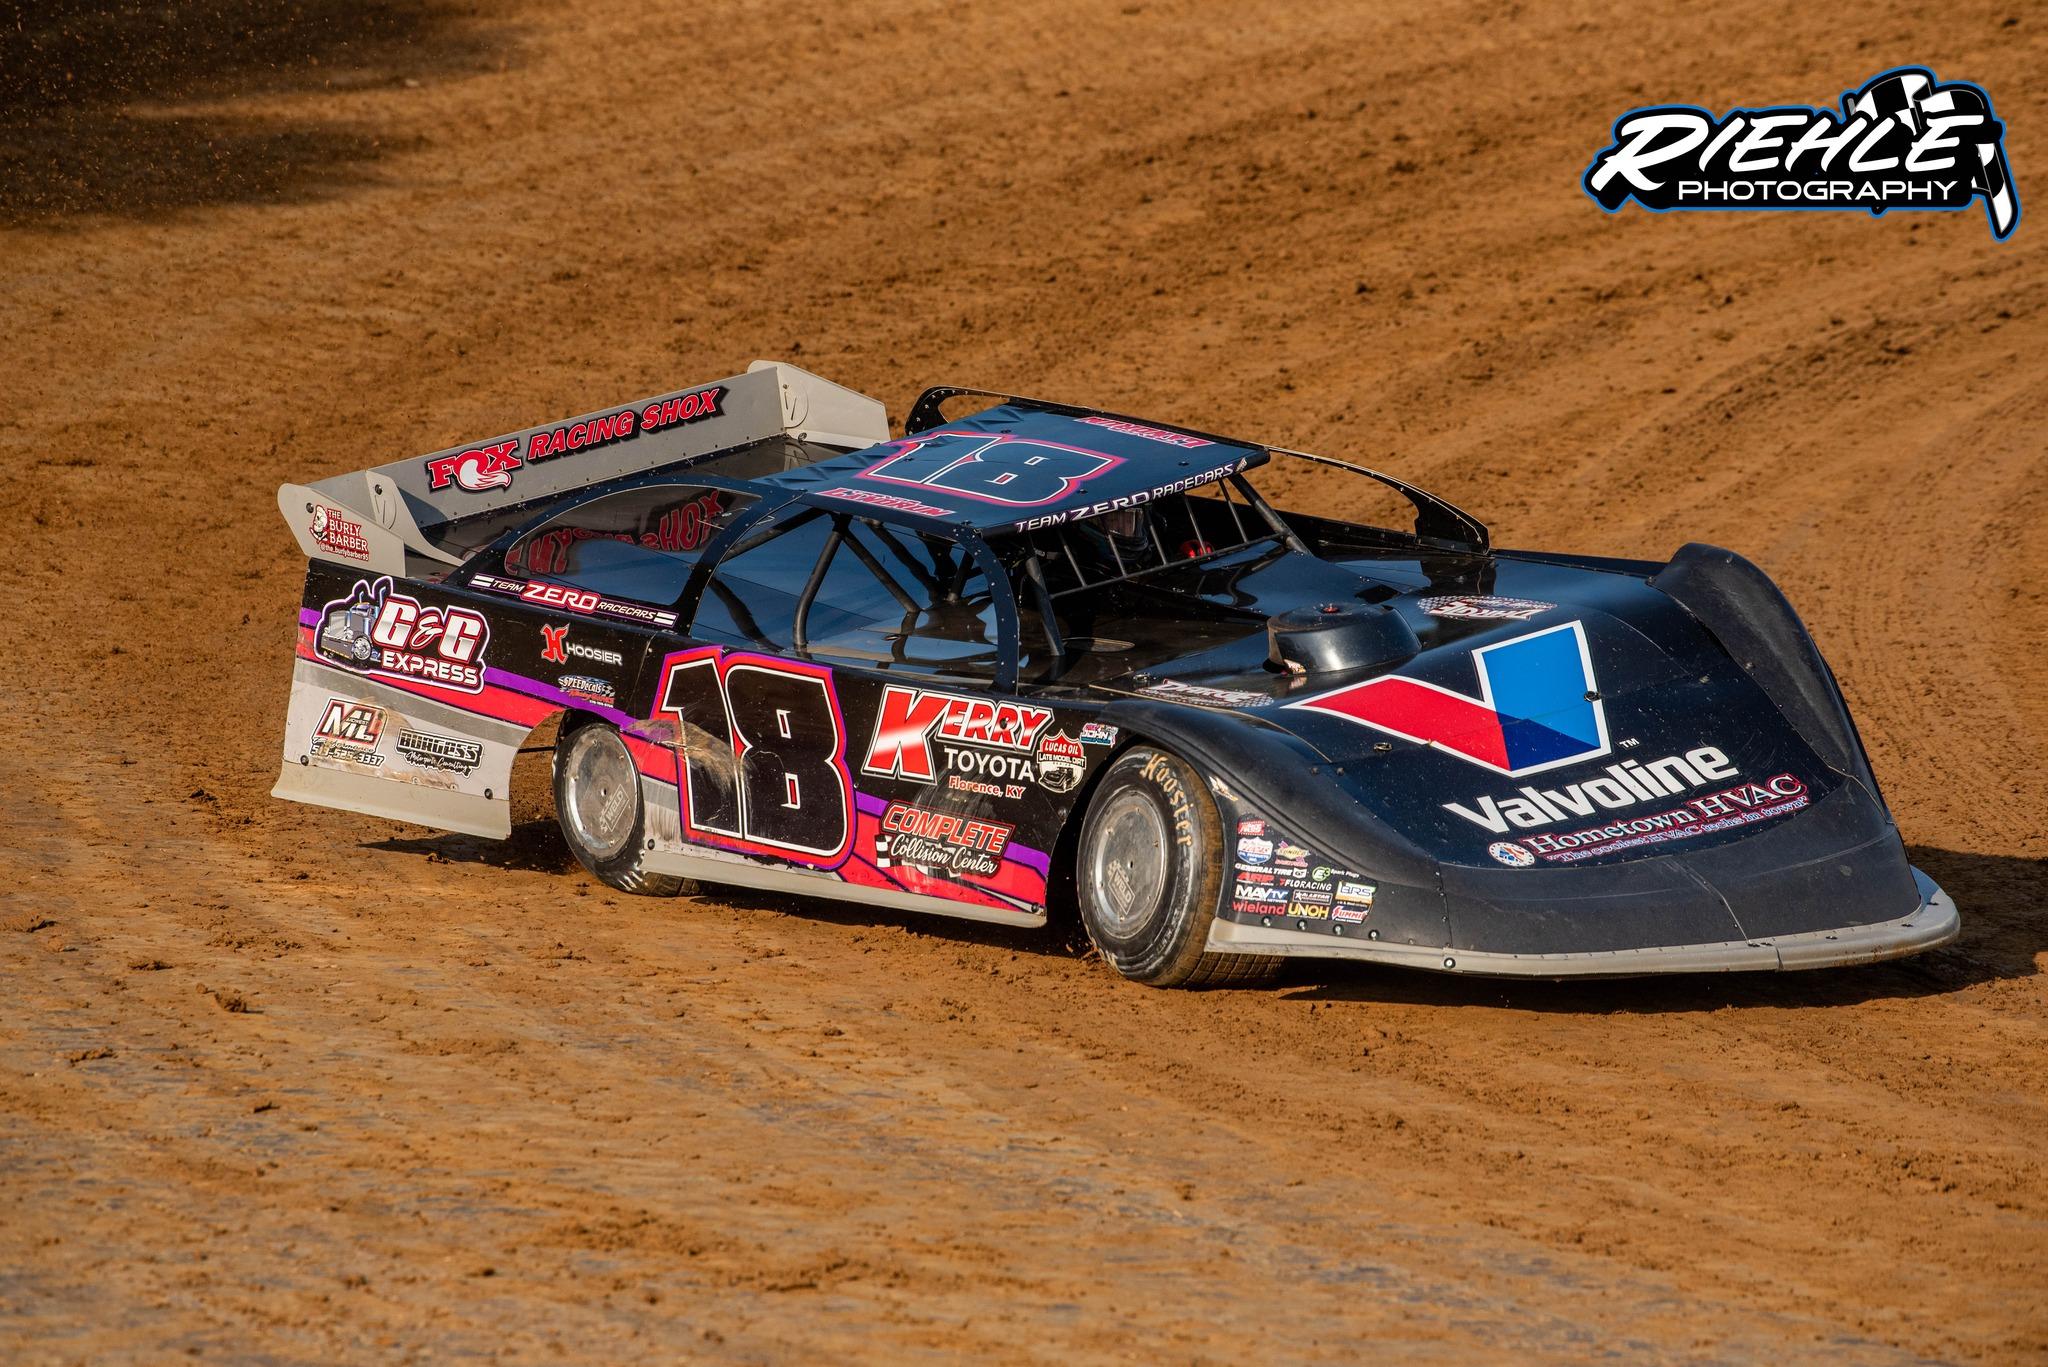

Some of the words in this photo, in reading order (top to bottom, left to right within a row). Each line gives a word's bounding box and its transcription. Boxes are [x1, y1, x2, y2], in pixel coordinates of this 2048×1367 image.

[429, 440, 522, 490] FOX
[528, 410, 634, 460] RACING
[640, 387, 720, 430] SHOX
[857, 431, 1124, 506] 18
[327, 508, 342, 520] THE
[1015, 511, 1067, 534] TEAM
[1070, 490, 1150, 522] ZERO
[1152, 463, 1235, 501] RACECARS
[329, 519, 361, 537] BURLY
[329, 531, 368, 552] BARBER
[491, 579, 525, 593] TEAM
[523, 582, 599, 611] ZERO
[597, 601, 656, 621] RACECARS
[373, 600, 482, 662] G&G
[381, 649, 479, 686] EXPRESS
[566, 641, 623, 666] HOOSIER
[863, 686, 1053, 781] KERRY
[1044, 741, 1067, 754] LUCAS
[1067, 745, 1079, 755] OIL
[1619, 737, 1640, 749] TM
[655, 650, 854, 864] 18
[944, 747, 1036, 783] TOYOTA
[1039, 752, 1053, 762] LATE
[1053, 755, 1072, 764] MODEL
[1072, 757, 1085, 767] DIRT
[948, 776, 1003, 798] Florence,
[1005, 785, 1027, 799] KY
[1139, 752, 1195, 847] Hoosier
[1442, 746, 1740, 834] Valvoline
[606, 790, 625, 821] WELD
[1522, 807, 1693, 856] Hometown
[1690, 775, 1804, 820] HVAC
[883, 804, 1010, 854] COMPLETE
[1592, 836, 1647, 857] coolest
[1646, 825, 1702, 844] HVAC
[1702, 815, 1745, 833] techs
[1743, 809, 1761, 823] in
[890, 833, 952, 864] Collision
[952, 846, 998, 874] Center
[1234, 862, 1273, 875] GENERAL
[1273, 867, 1294, 877] TIRE
[1112, 871, 1133, 903] WELD
[1234, 884, 1289, 900] MAVTV
[1284, 878, 1332, 892] FLORACING
[1232, 900, 1287, 916] wieland
[1287, 902, 1330, 918] UNOH
